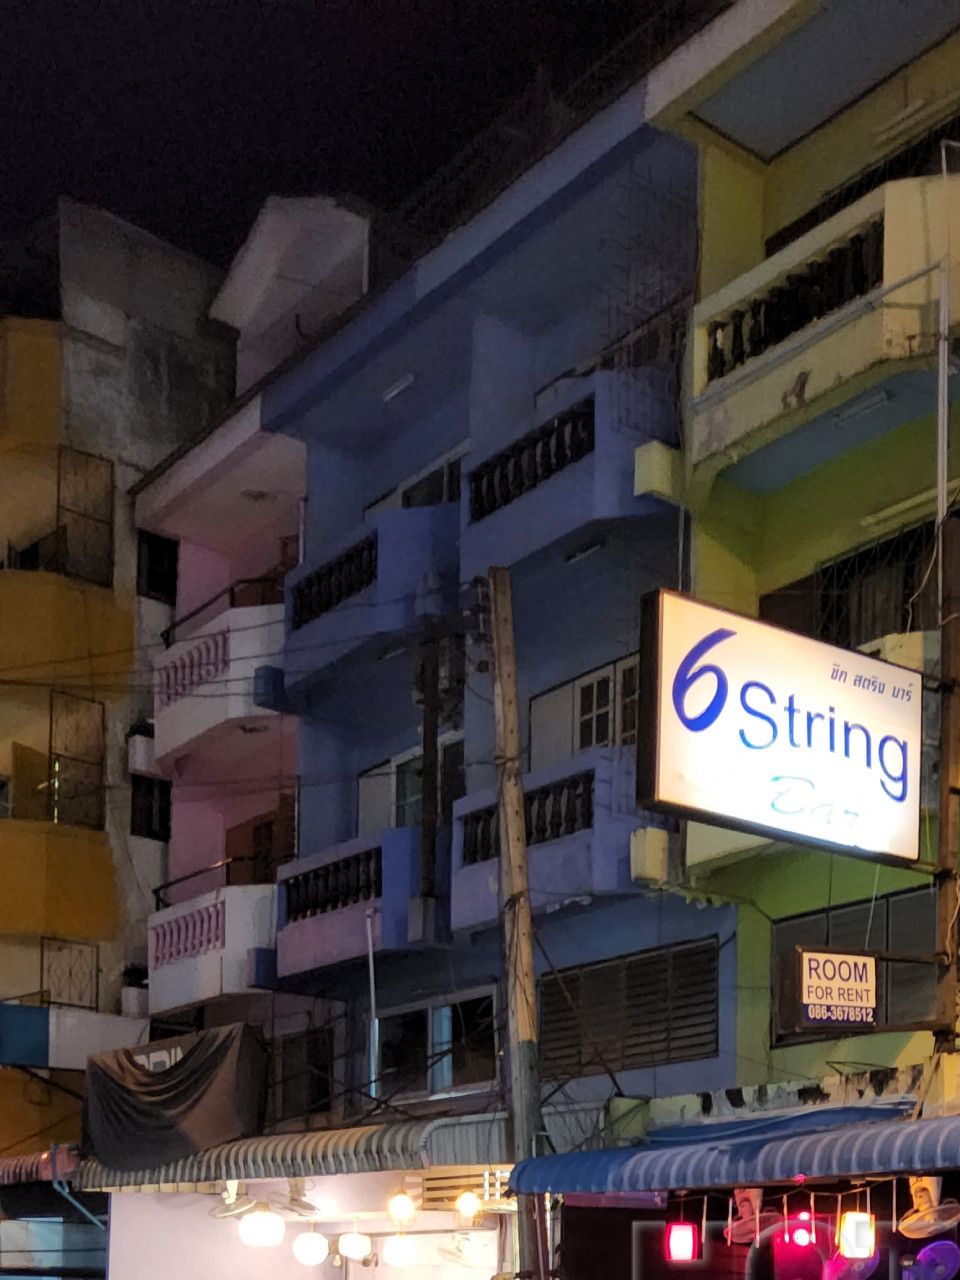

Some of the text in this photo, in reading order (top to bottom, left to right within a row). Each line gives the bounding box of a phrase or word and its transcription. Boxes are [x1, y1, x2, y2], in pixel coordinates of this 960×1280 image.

[672, 627, 910, 802] 6 String
[808, 957, 869, 984] ROOM
[807, 984, 871, 1004] FOR RENT
[808, 1004, 875, 1024] 086-3678512
